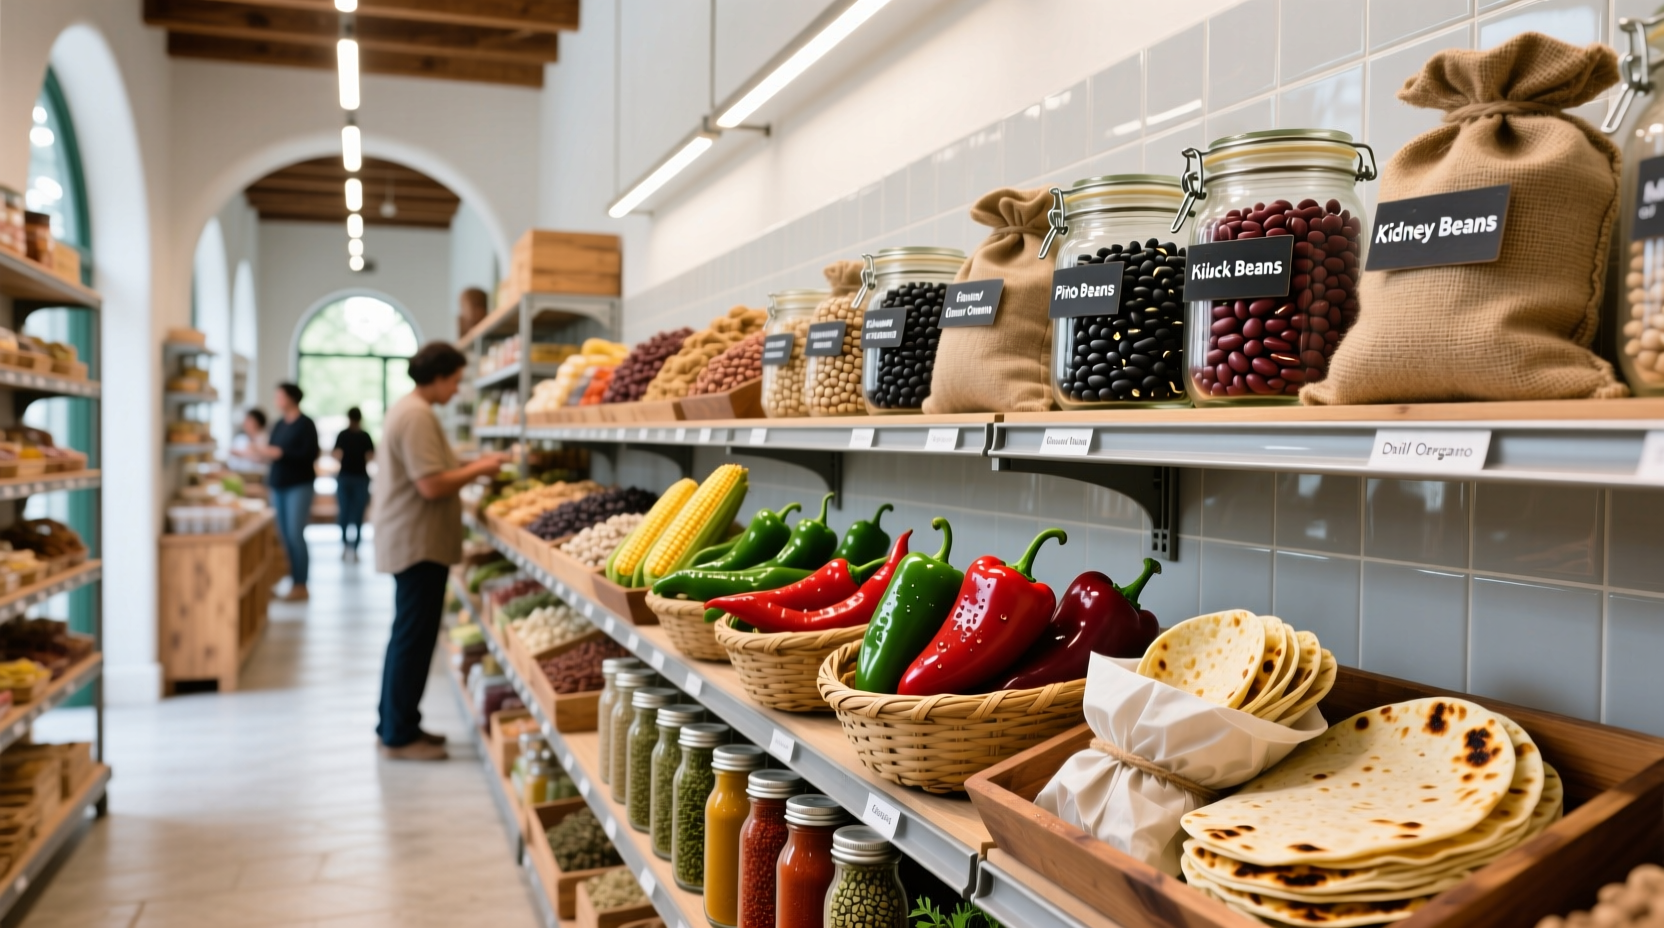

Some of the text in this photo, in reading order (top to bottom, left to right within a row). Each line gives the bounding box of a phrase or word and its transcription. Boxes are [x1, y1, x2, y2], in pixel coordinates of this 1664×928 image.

[1375, 215, 1498, 244] Kidney Beans
[1234, 260, 1283, 277] Beans
